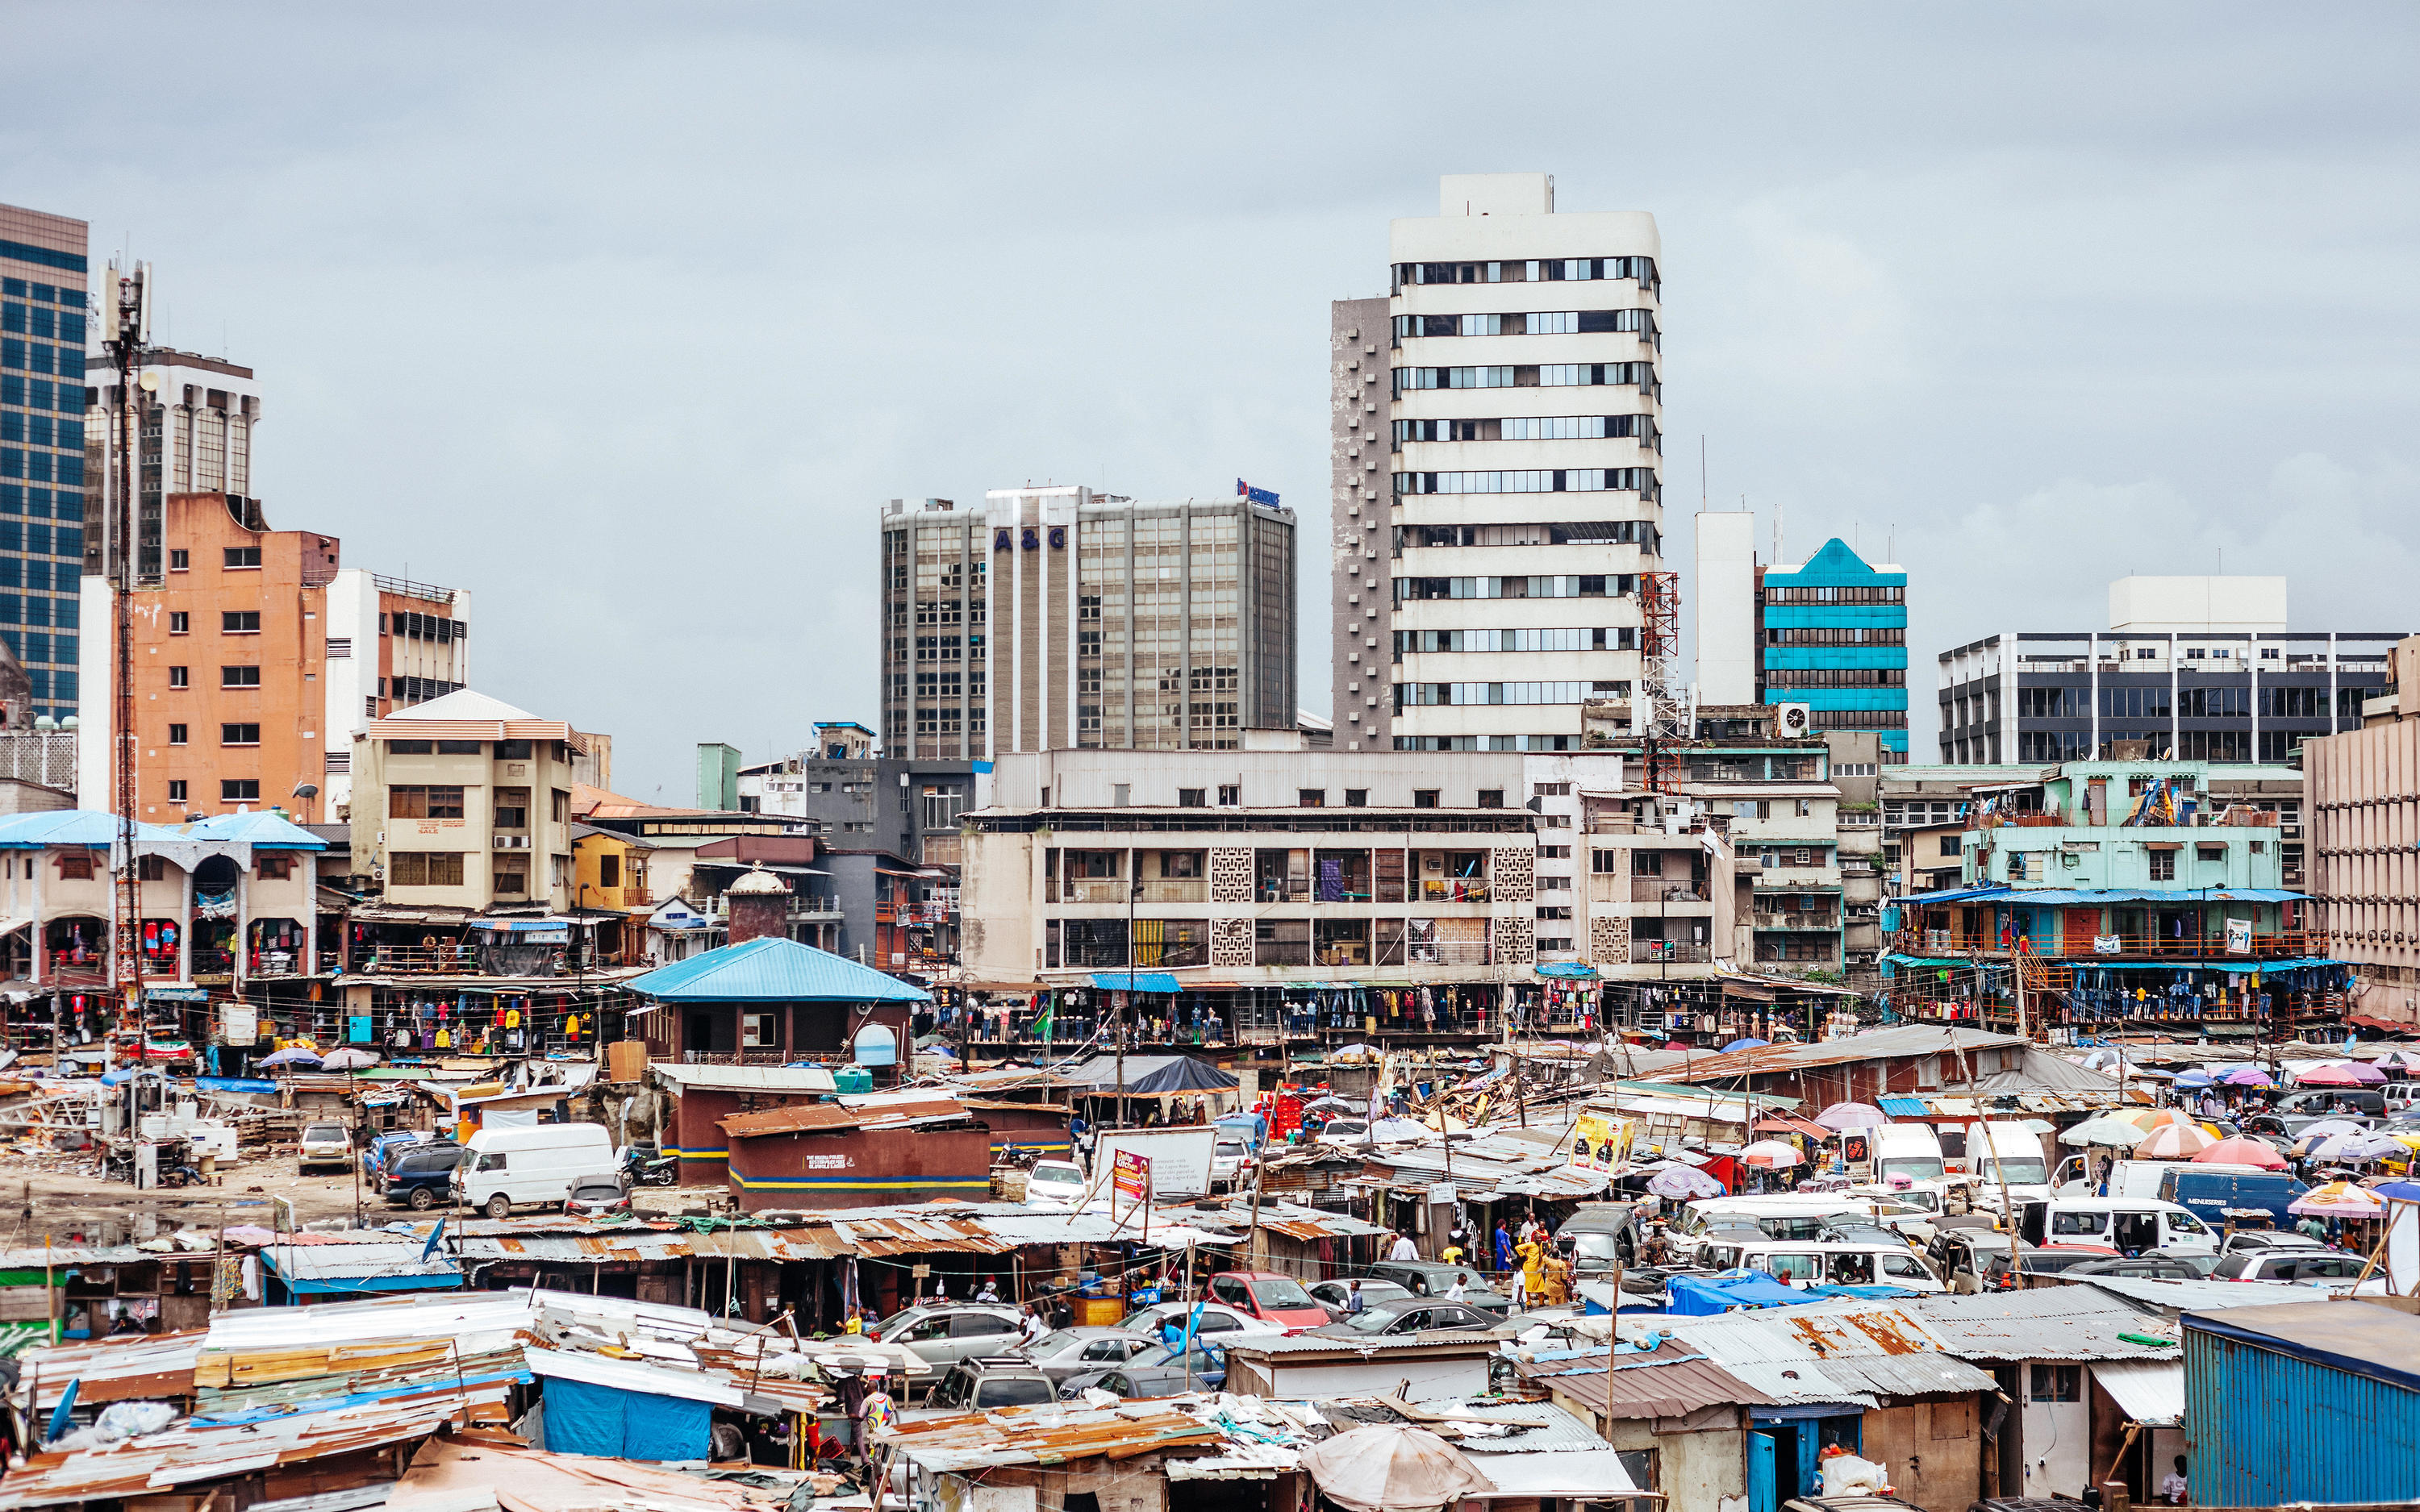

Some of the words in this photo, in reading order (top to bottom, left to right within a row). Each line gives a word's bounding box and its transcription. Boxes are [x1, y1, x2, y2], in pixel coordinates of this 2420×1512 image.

[994, 530, 1012, 550] A
[1021, 529, 1040, 549] &
[1049, 528, 1064, 548] G
[1771, 576, 1800, 584] UNION
[1802, 576, 1864, 584] ASSURANCE
[1867, 575, 1902, 584] TOWER
[1116, 1158, 1138, 1172] Kitchen
[2188, 1198, 2226, 1206] MENUISERIES
